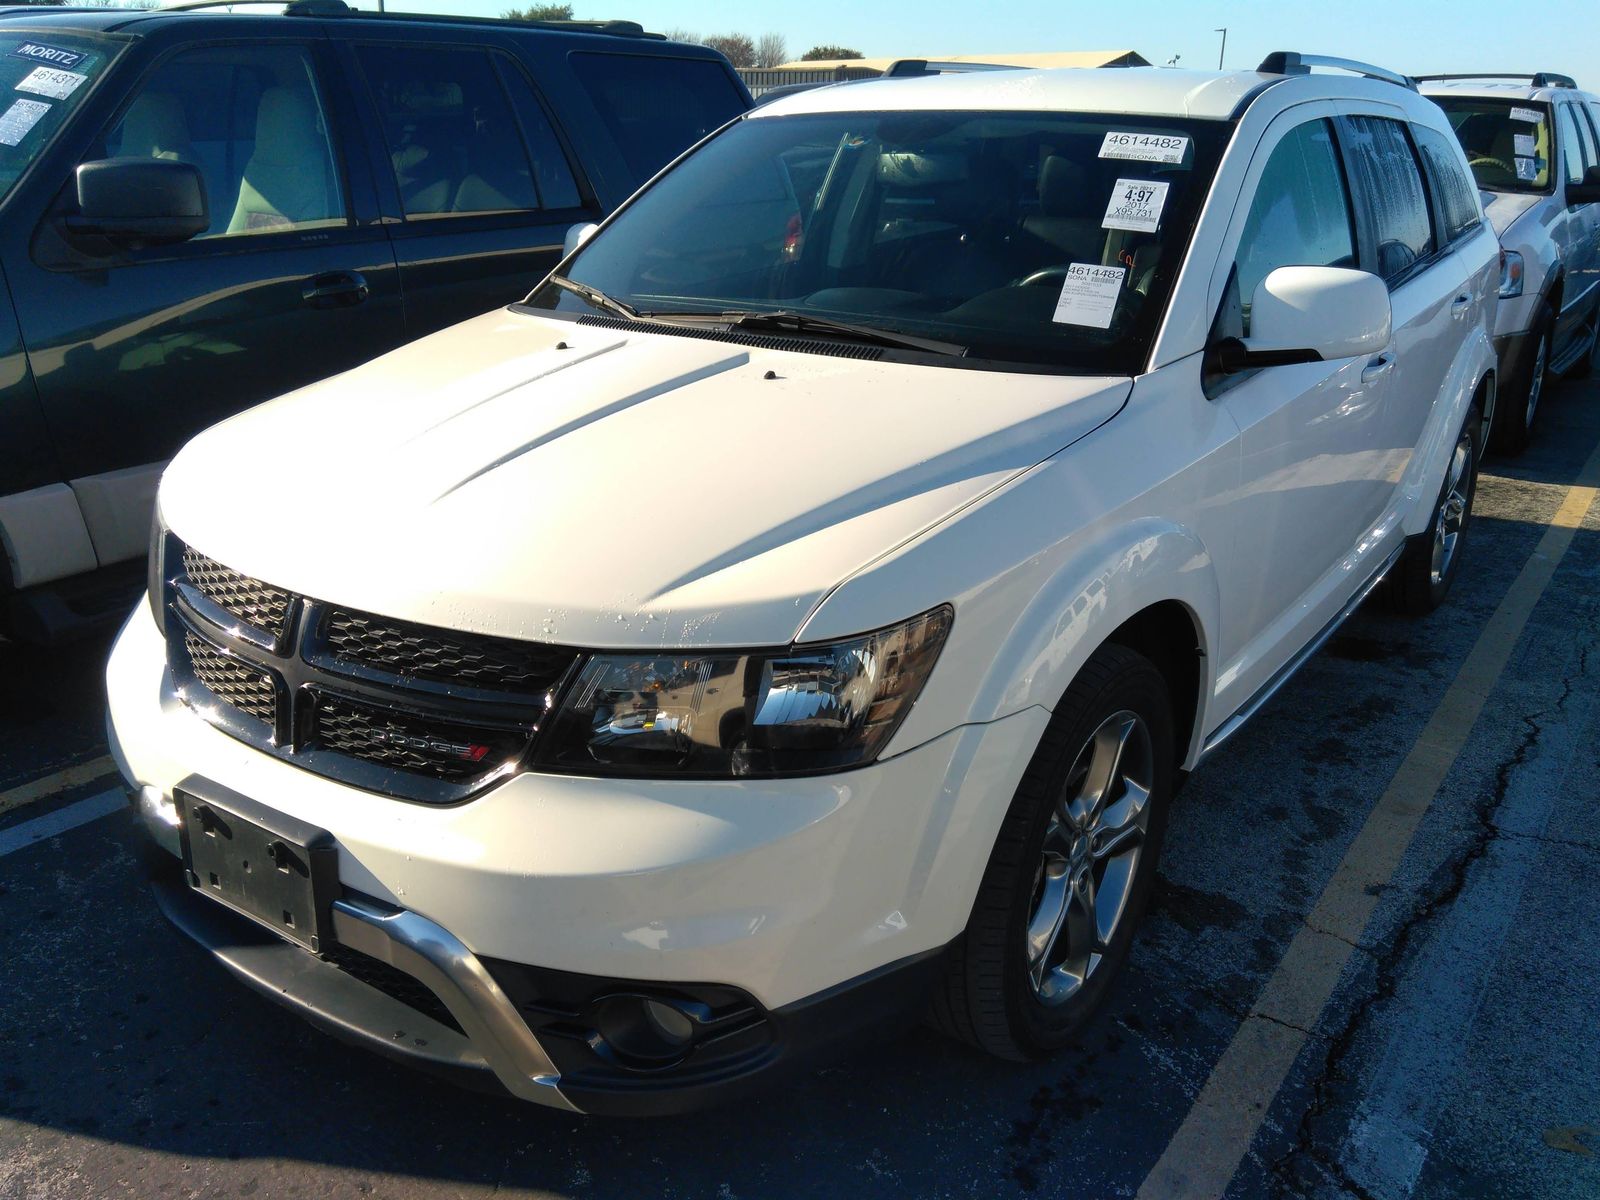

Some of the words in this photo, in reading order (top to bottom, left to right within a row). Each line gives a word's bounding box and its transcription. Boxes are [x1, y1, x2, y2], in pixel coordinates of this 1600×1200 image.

[17, 44, 79, 64] MORITZ
[33, 70, 80, 87] 4614371
[1108, 135, 1182, 149] 4614482
[1125, 190, 1154, 203] 4:97
[1125, 201, 1149, 209] 2017
[1068, 266, 1124, 280] 4614482
[370, 728, 472, 757] DODGE
